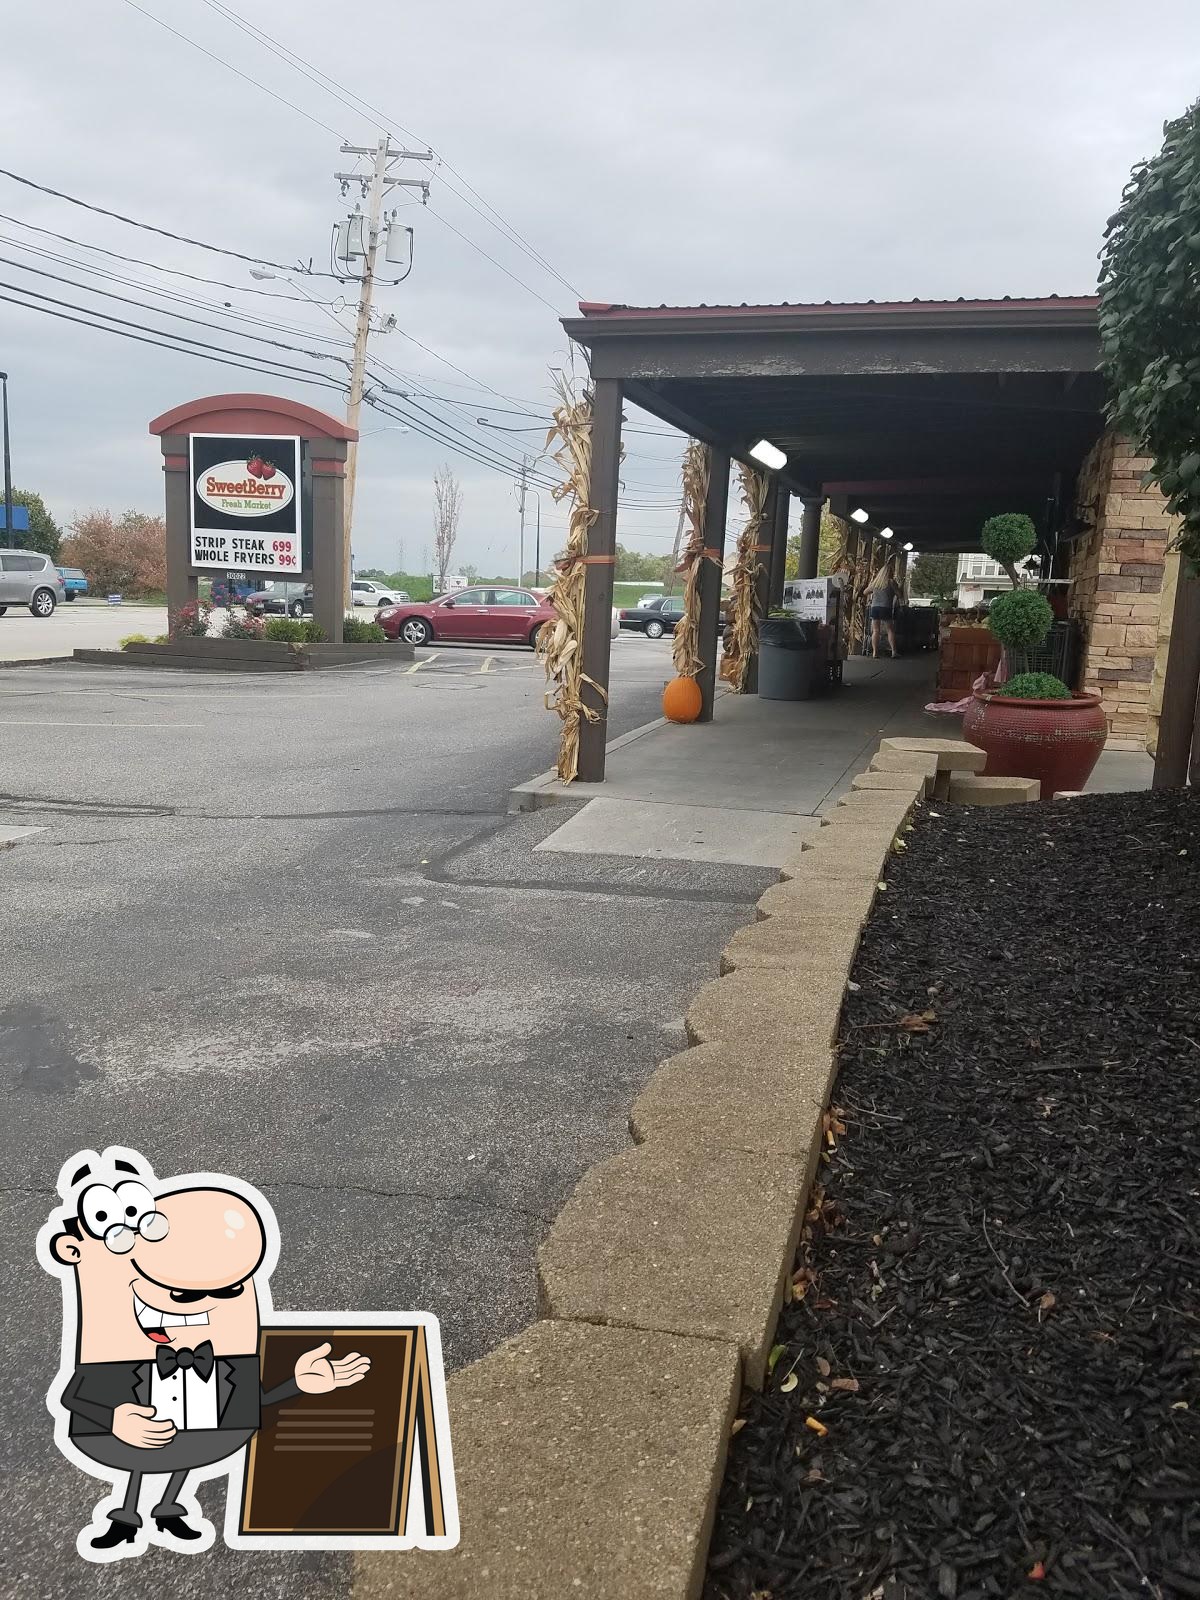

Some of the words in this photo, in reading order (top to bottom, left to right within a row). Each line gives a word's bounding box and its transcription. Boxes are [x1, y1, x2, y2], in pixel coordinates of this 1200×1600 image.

[206, 476, 286, 499] SweetBerry
[221, 498, 243, 509] Fresh
[244, 500, 272, 510] Market
[195, 536, 226, 549] STRIP
[232, 538, 265, 551] STEAK
[272, 540, 292, 552] 699
[194, 549, 229, 562] WHOLE
[234, 552, 275, 565] FRYERS
[278, 555, 297, 566] 99¢
